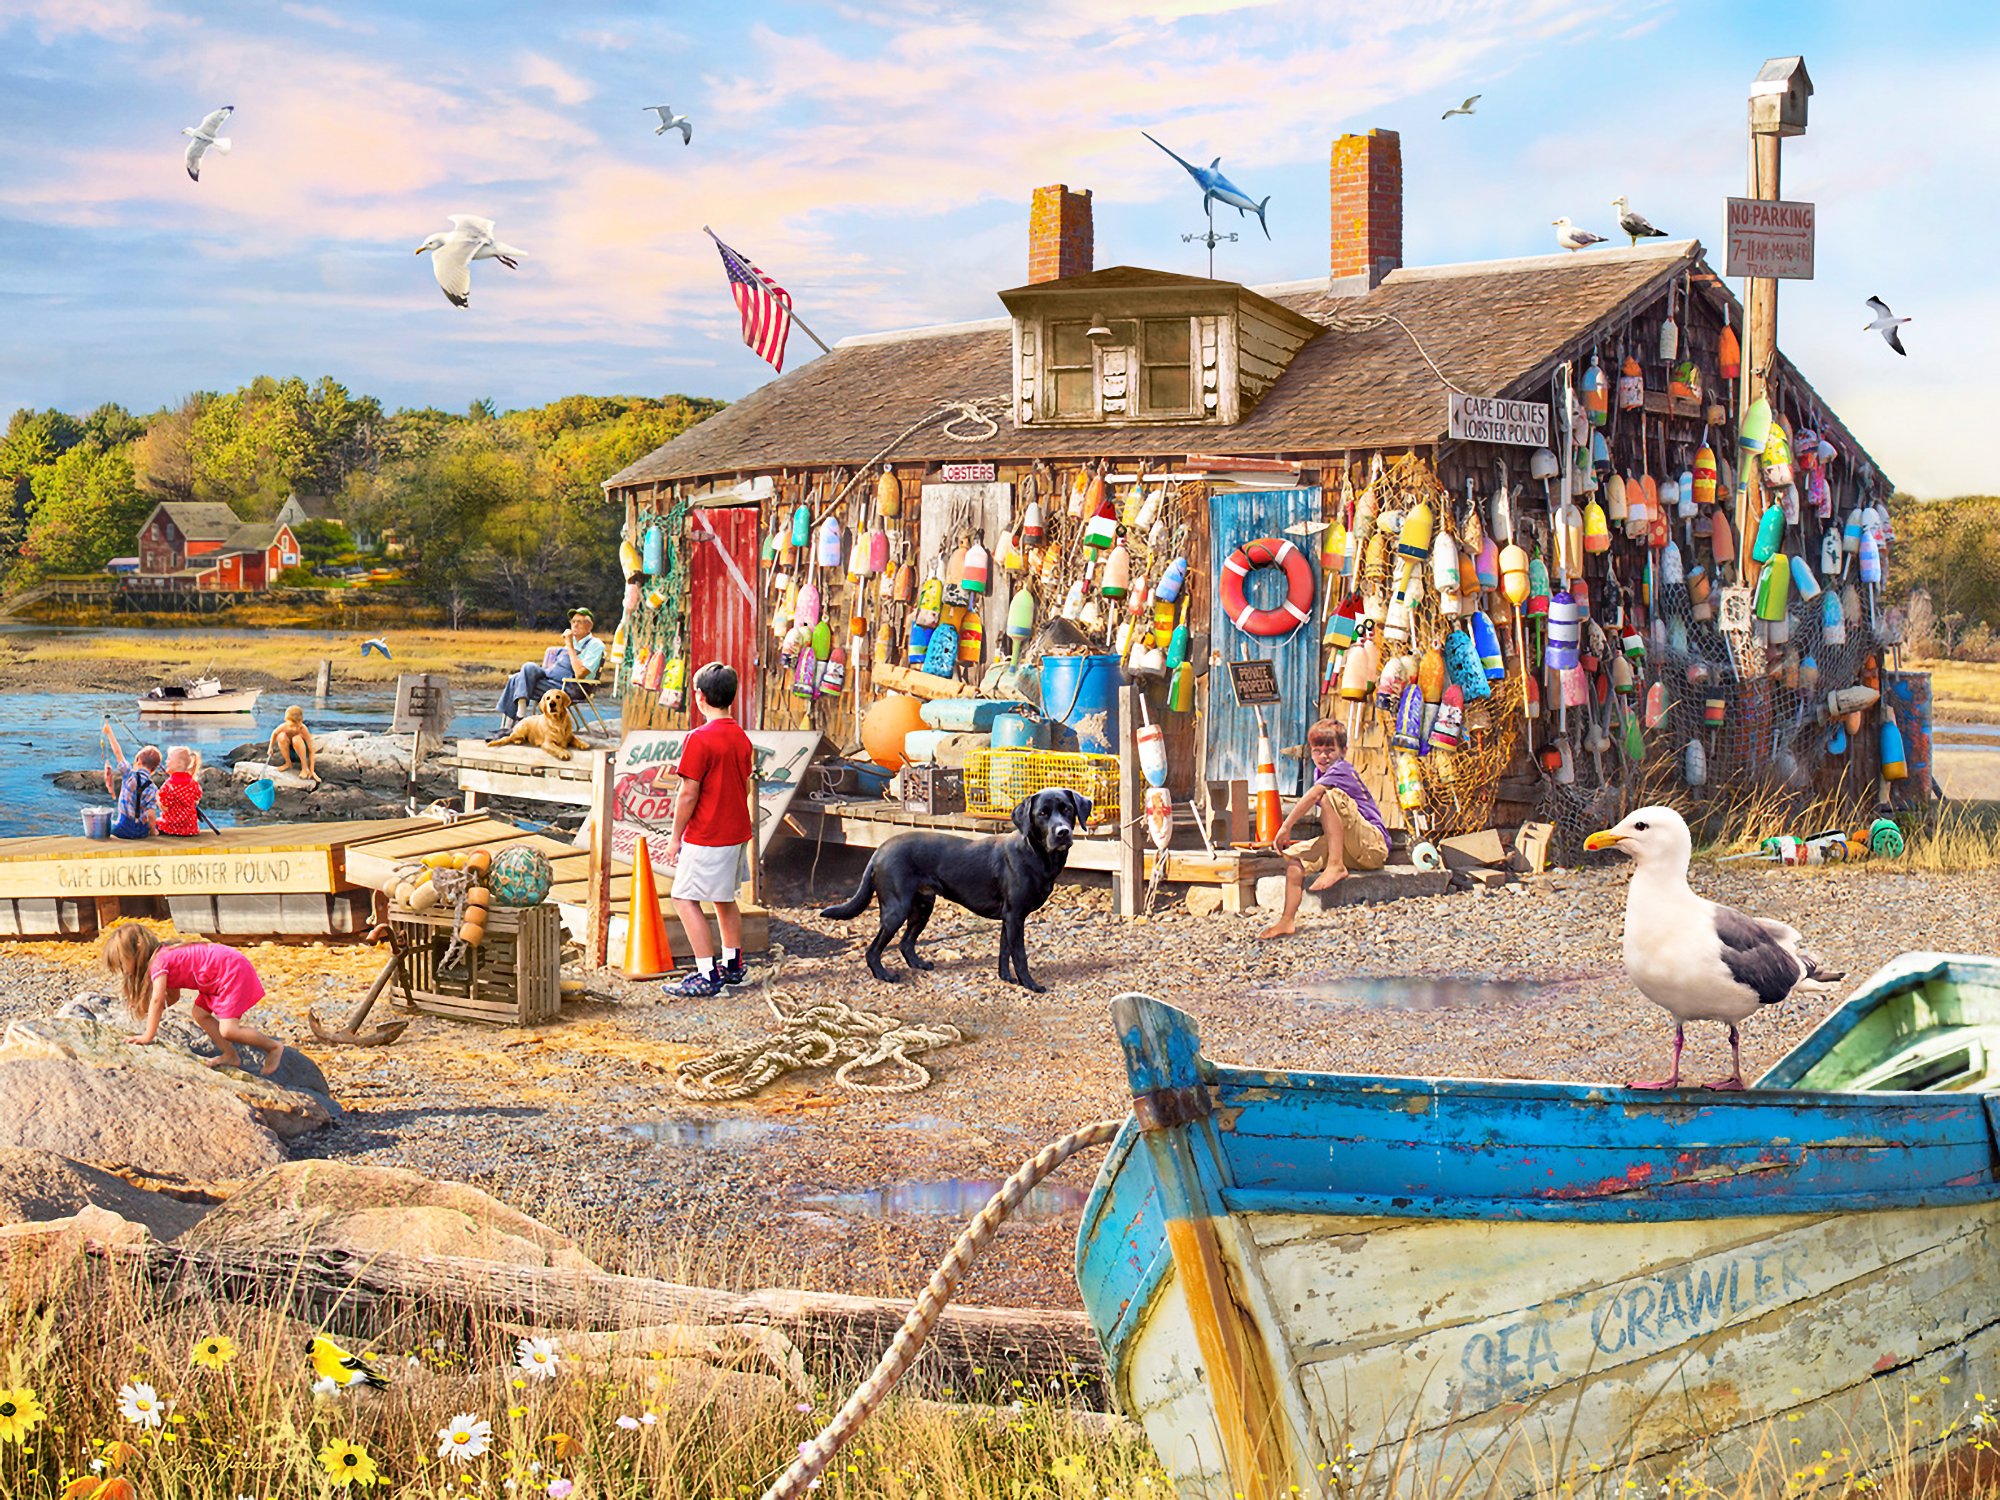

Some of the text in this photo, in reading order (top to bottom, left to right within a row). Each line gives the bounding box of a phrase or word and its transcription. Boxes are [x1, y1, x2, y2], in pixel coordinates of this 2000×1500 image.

[1181, 233, 1193, 243] W
[1464, 397, 1545, 425] CAPE DICKIES
[1464, 419, 1546, 445] LOBSTER POUND
[626, 796, 675, 819] LOB
[58, 859, 290, 888] CAPE DICKIES LOBSTER POUND
[1461, 1249, 1809, 1393] SEA CRAWLER
